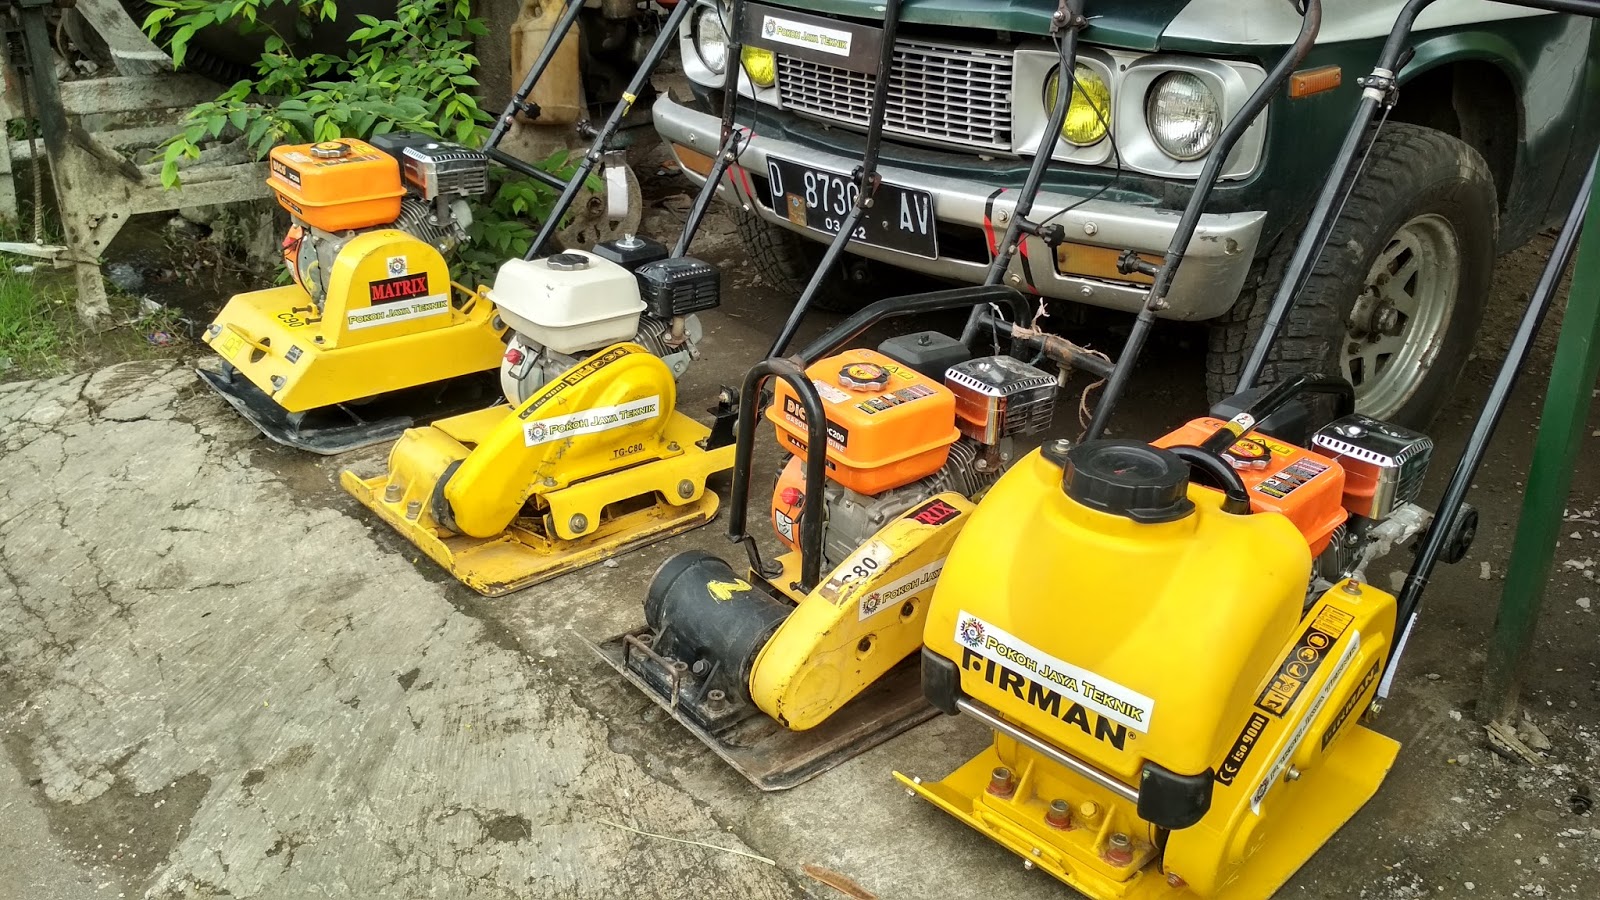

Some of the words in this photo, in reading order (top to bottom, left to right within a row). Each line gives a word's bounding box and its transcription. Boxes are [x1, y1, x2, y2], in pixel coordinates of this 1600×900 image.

[768, 161, 783, 197] D
[900, 192, 928, 235] AV
[371, 277, 427, 300] MATRIX
[278, 313, 304, 327] C90
[348, 311, 385, 325] POKOH
[386, 307, 411, 318] JAYA
[412, 300, 448, 313] TEKNIK
[549, 419, 589, 436] POKOH
[590, 412, 618, 428] JAYA
[619, 403, 656, 420] TEKNIK
[786, 399, 806, 421] DIC
[613, 443, 643, 458] TG-C80
[882, 577, 920, 604] POKOH
[985, 635, 1038, 673] POKOH
[1038, 664, 1078, 693] JAYA
[1082, 680, 1145, 723] TEKNIK
[961, 646, 1127, 751] FIRMAN
[1242, 715, 1265, 745] 9001
